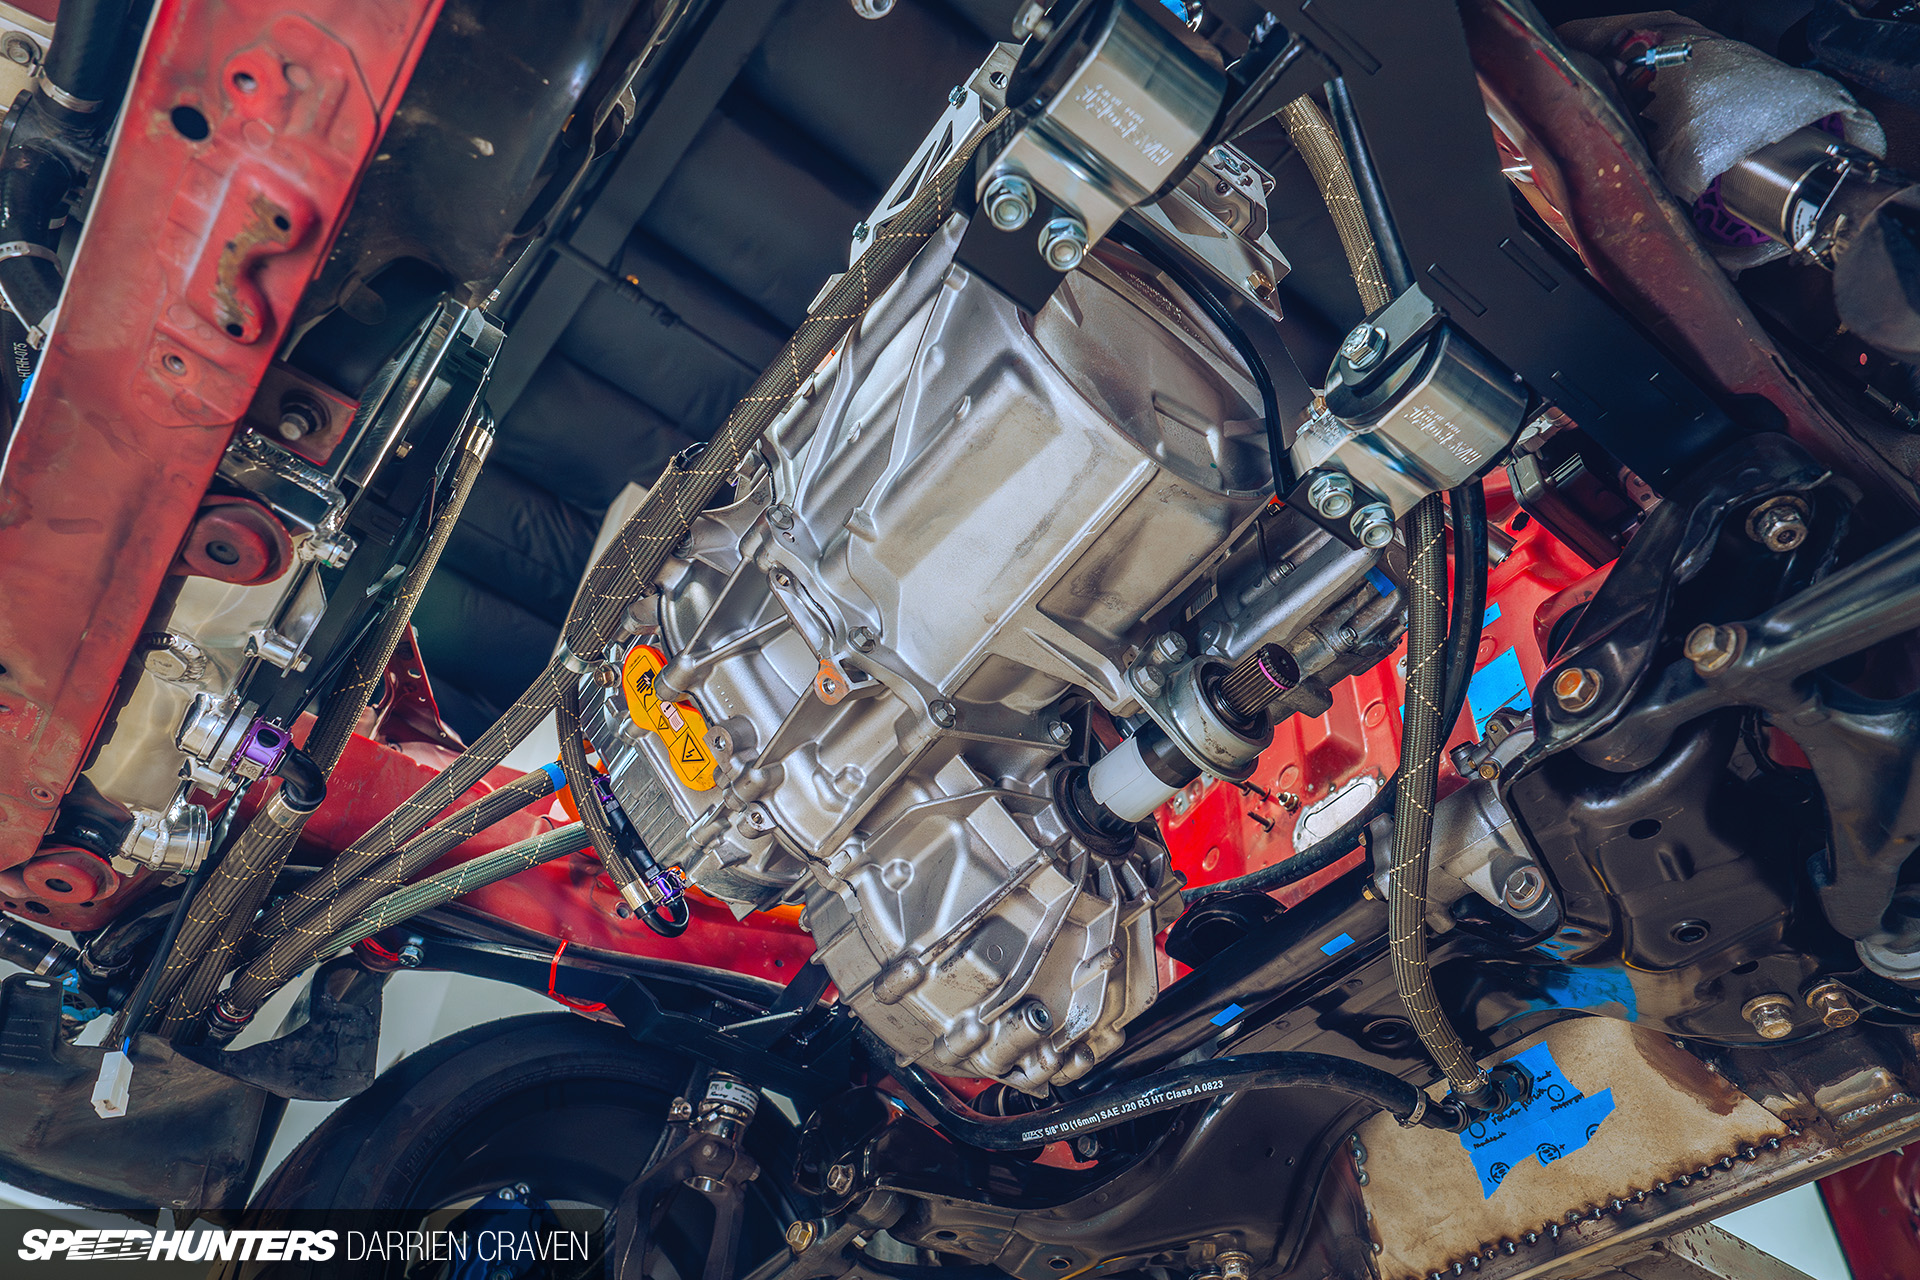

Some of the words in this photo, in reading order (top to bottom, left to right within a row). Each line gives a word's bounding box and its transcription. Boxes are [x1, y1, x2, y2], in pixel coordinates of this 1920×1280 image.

[1045, 1124, 1059, 1136] 5/8"
[1060, 1122, 1070, 1132] ID
[1070, 1112, 1101, 1131] (16mm)
[1100, 1107, 1120, 1120] SAE
[1121, 1102, 1137, 1114] J20
[1137, 1098, 1151, 1109] R3
[1152, 1094, 1165, 1105] HT
[1166, 1087, 1193, 1101] Class
[1193, 1085, 1202, 1094] A
[1201, 1079, 1224, 1092] 0823
